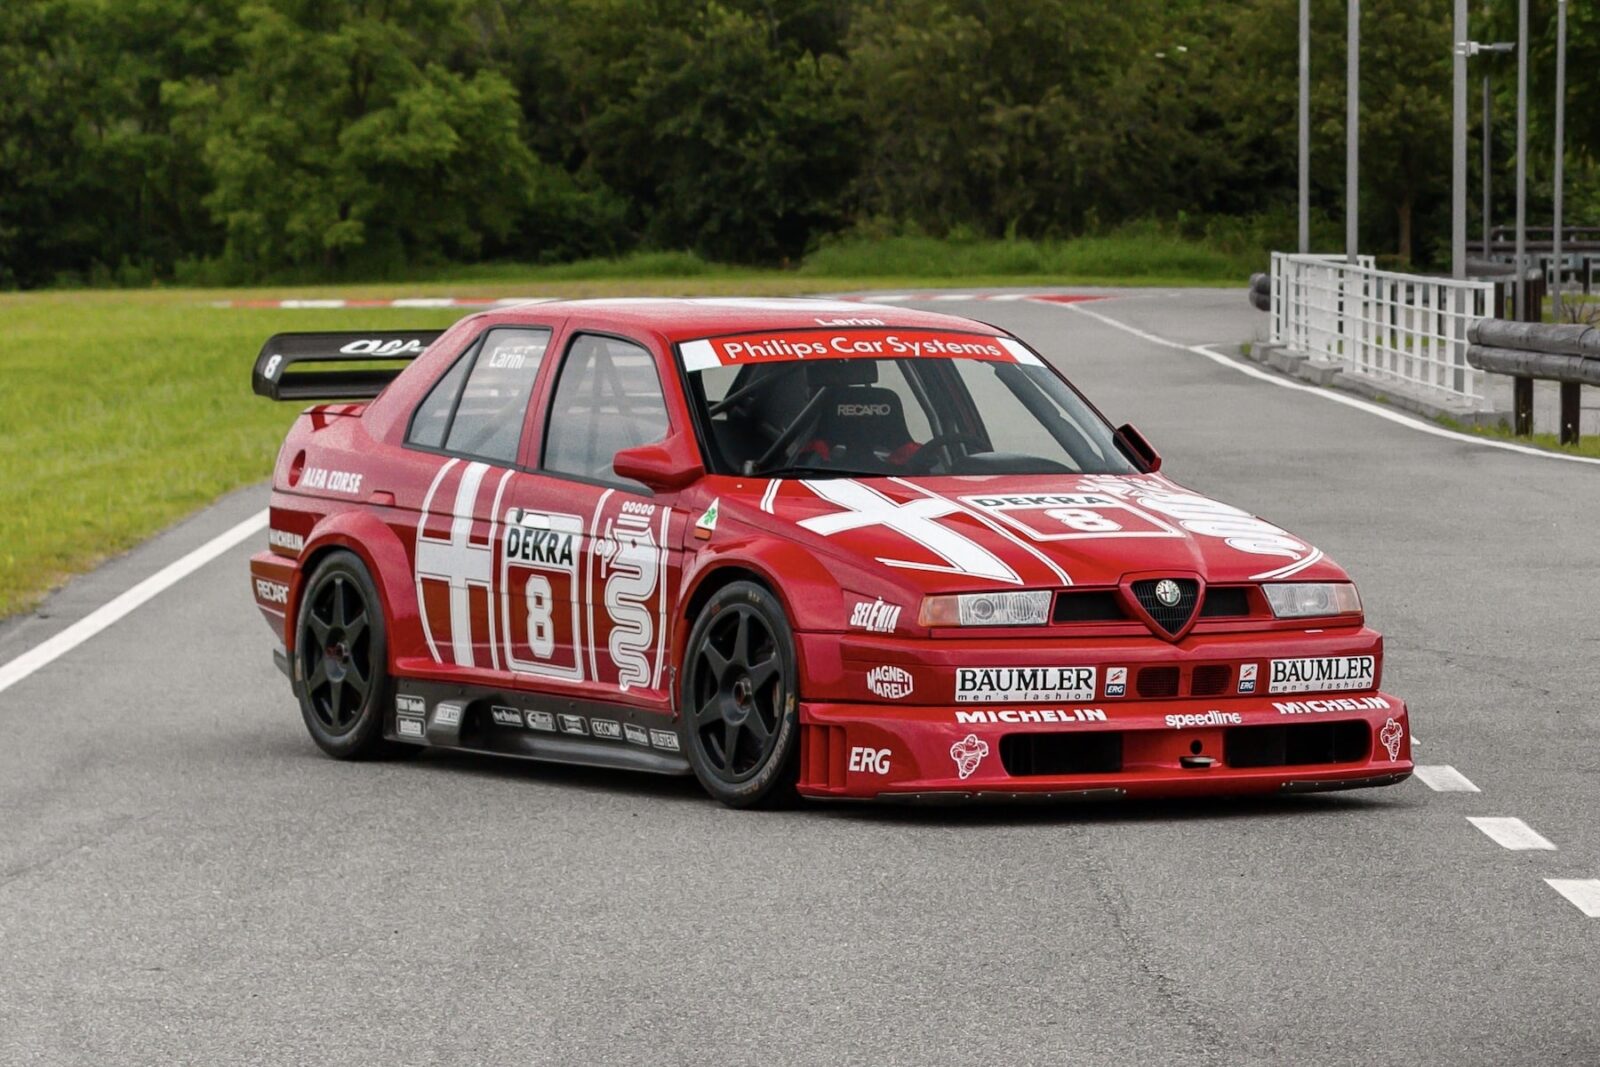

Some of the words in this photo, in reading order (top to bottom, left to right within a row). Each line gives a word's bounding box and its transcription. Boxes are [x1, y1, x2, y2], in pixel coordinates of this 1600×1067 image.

[814, 317, 885, 327] Larini
[489, 346, 526, 369] Larini
[723, 339, 828, 359] Philips
[830, 336, 883, 354] Car
[885, 335, 1002, 357] Systems
[264, 354, 282, 379] 8
[837, 403, 891, 417] RECARO
[302, 467, 328, 490] ALFA
[327, 470, 363, 494] CORSE
[971, 495, 1114, 508] DEKRA
[1043, 508, 1123, 532] 8
[506, 528, 573, 566] DEKRA
[256, 578, 290, 604] RECAR
[525, 574, 555, 660] 8
[958, 668, 1094, 692] BÄUMLER
[1272, 657, 1373, 683] BÄUMLER
[958, 692, 1009, 701] men's
[1023, 692, 1093, 701] fashion
[1107, 686, 1124, 694] ERG
[1239, 681, 1255, 690] ERG
[1270, 683, 1310, 692] men's
[1320, 681, 1371, 690] fashion
[955, 709, 1108, 724] MICHELIN
[1272, 697, 1391, 714] MICHELIN
[1165, 710, 1242, 729] speedline
[849, 746, 892, 775] ERG
